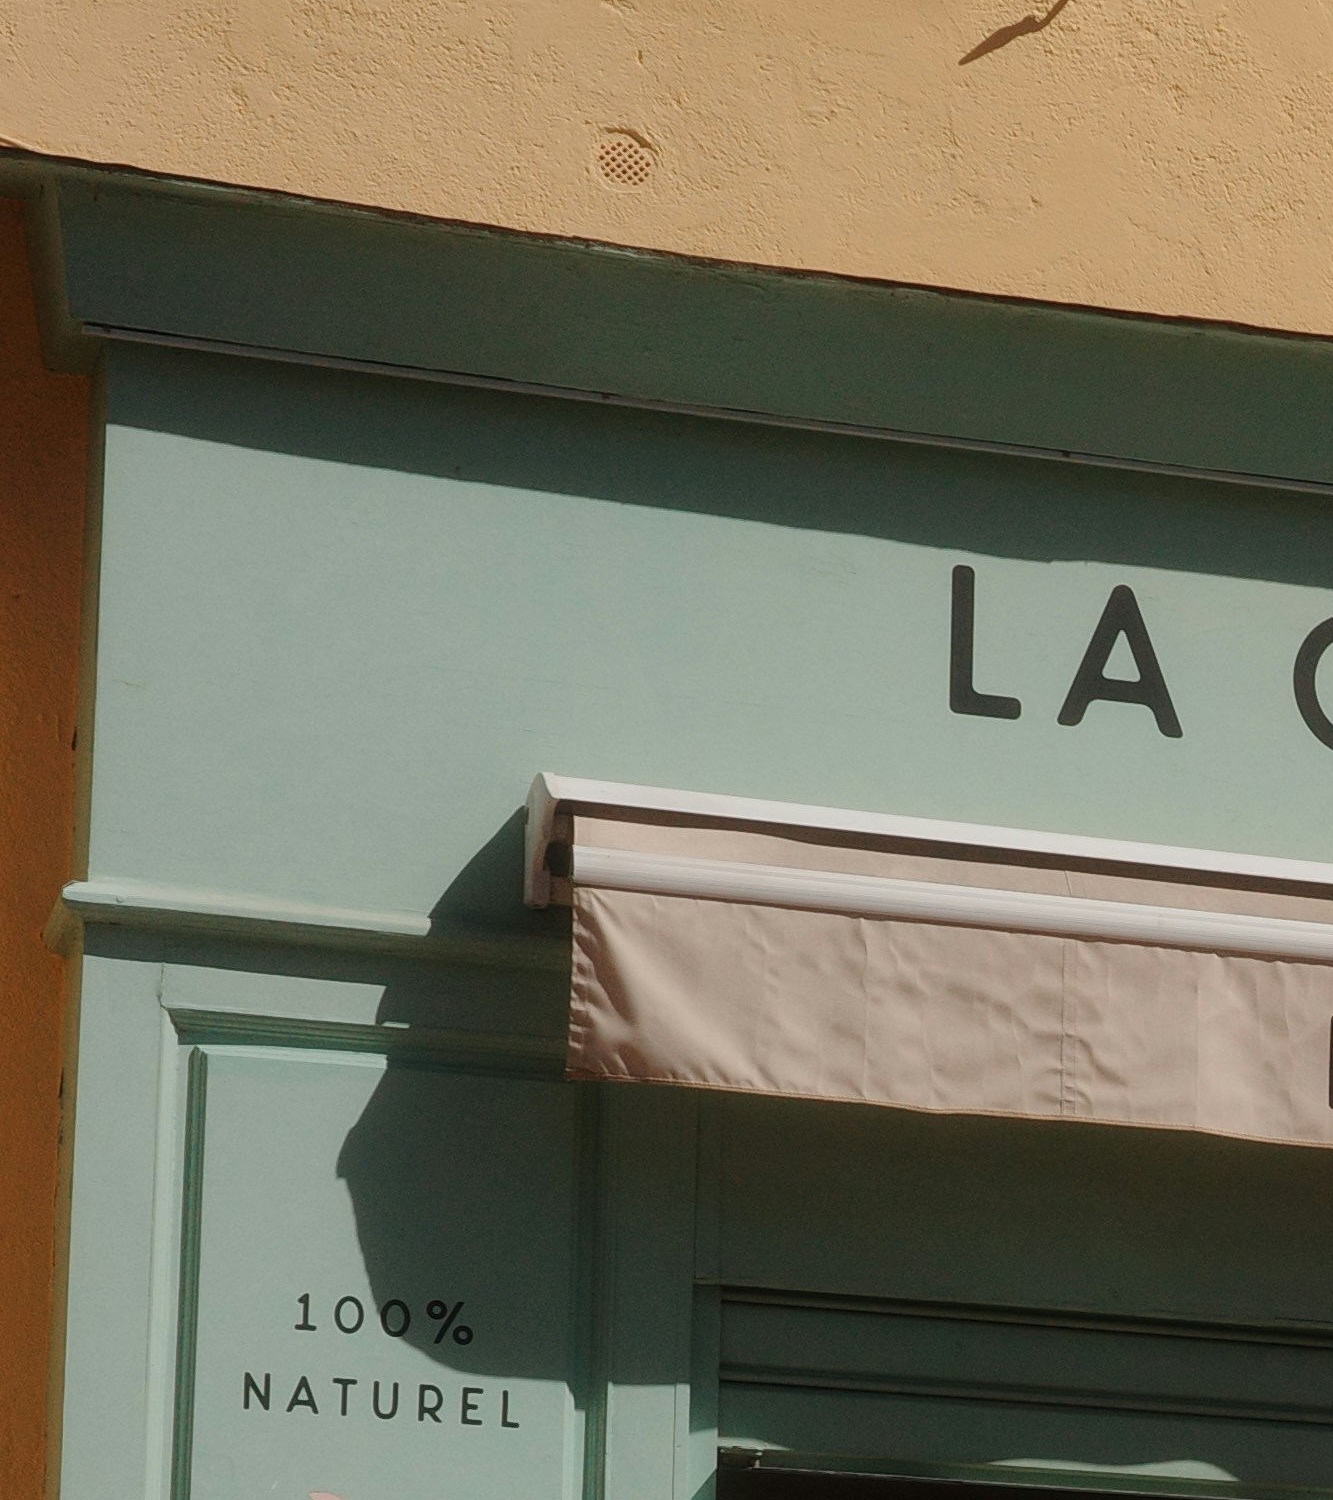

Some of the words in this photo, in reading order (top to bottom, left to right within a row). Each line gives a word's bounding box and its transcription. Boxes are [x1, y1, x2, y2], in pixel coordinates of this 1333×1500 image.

[951, 564, 1182, 739] LA
[295, 1291, 476, 1348] 100%
[242, 1370, 522, 1430] NATUREL
